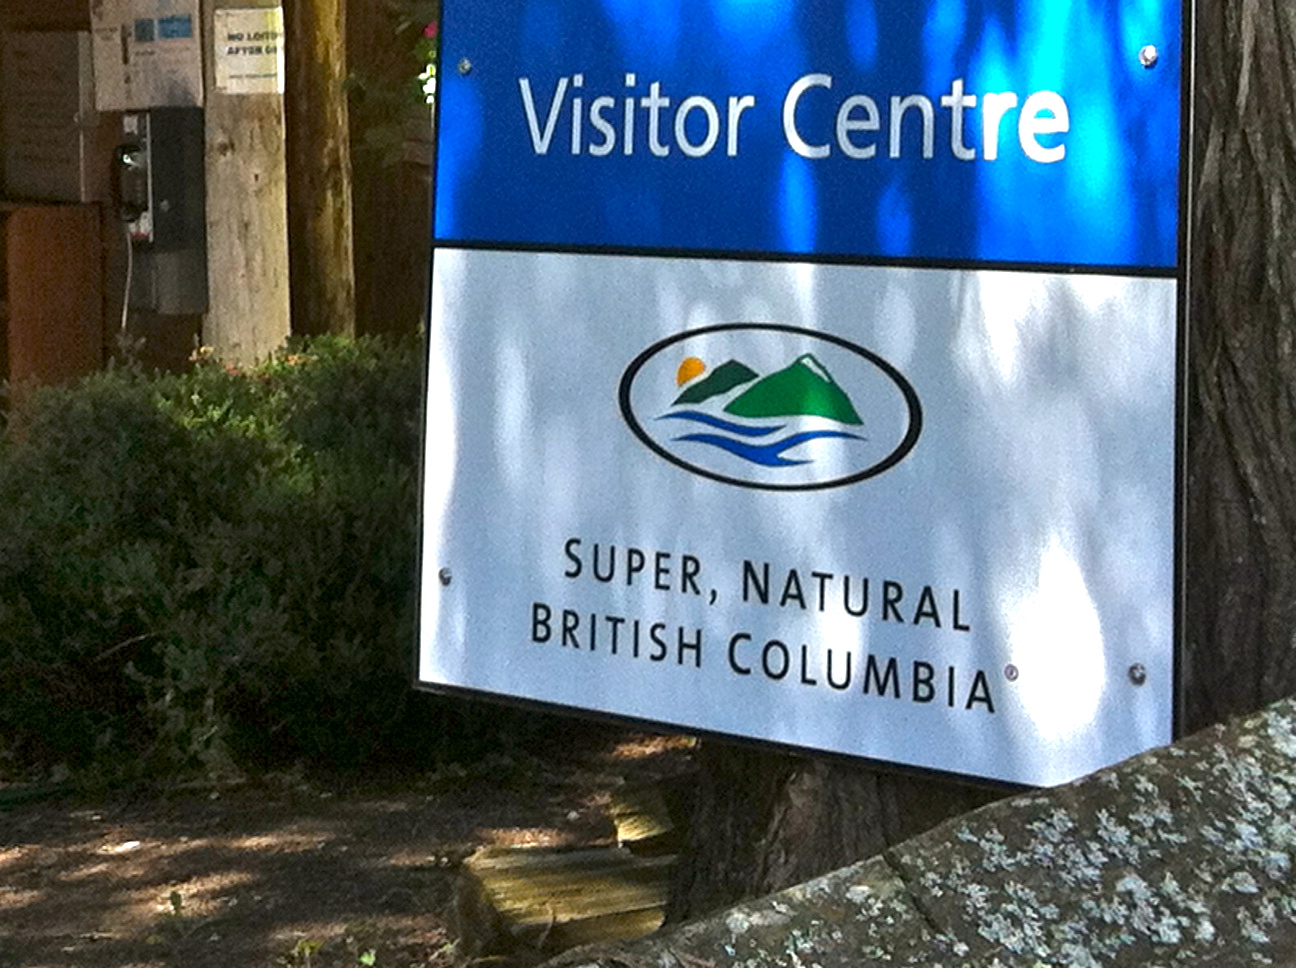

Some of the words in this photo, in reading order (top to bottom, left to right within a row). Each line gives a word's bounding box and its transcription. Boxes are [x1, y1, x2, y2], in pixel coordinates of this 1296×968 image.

[518, 74, 755, 157] Visitor
[782, 73, 1070, 163] Centre
[564, 538, 719, 605] SUPER,
[741, 560, 971, 632] NATURAL
[530, 602, 703, 668] BRITISH
[727, 632, 996, 714] COLUMBIA
